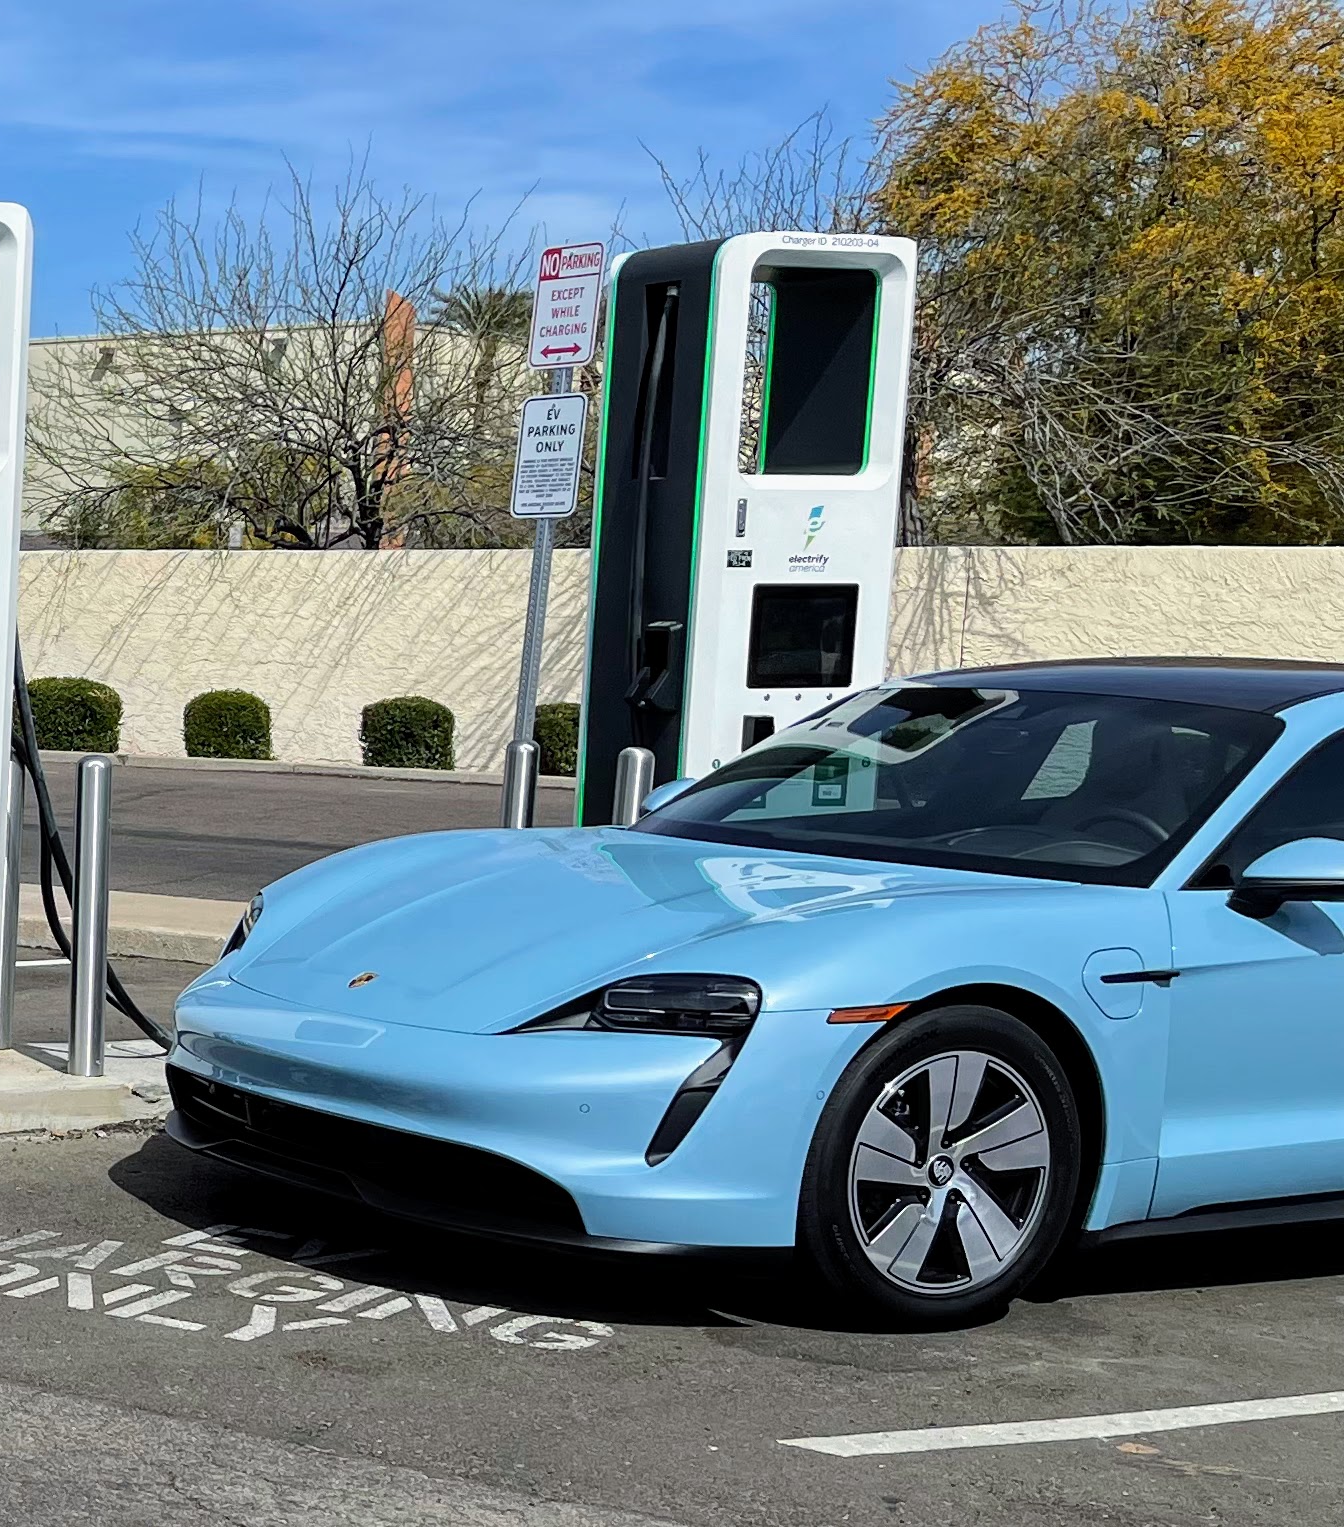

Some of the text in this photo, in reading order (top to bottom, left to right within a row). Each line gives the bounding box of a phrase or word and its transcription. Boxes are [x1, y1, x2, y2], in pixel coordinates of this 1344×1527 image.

[782, 235, 879, 247] Charger ID 210203-04
[541, 252, 600, 277] NO PARKING
[551, 286, 585, 301] EXCEPT
[551, 305, 580, 319] WHILE
[539, 322, 587, 337] CHARGING
[547, 408, 561, 420] EV
[527, 424, 575, 437] PARKING
[536, 440, 564, 453] ONLY
[789, 554, 829, 565] electrify
[789, 564, 825, 572] america
